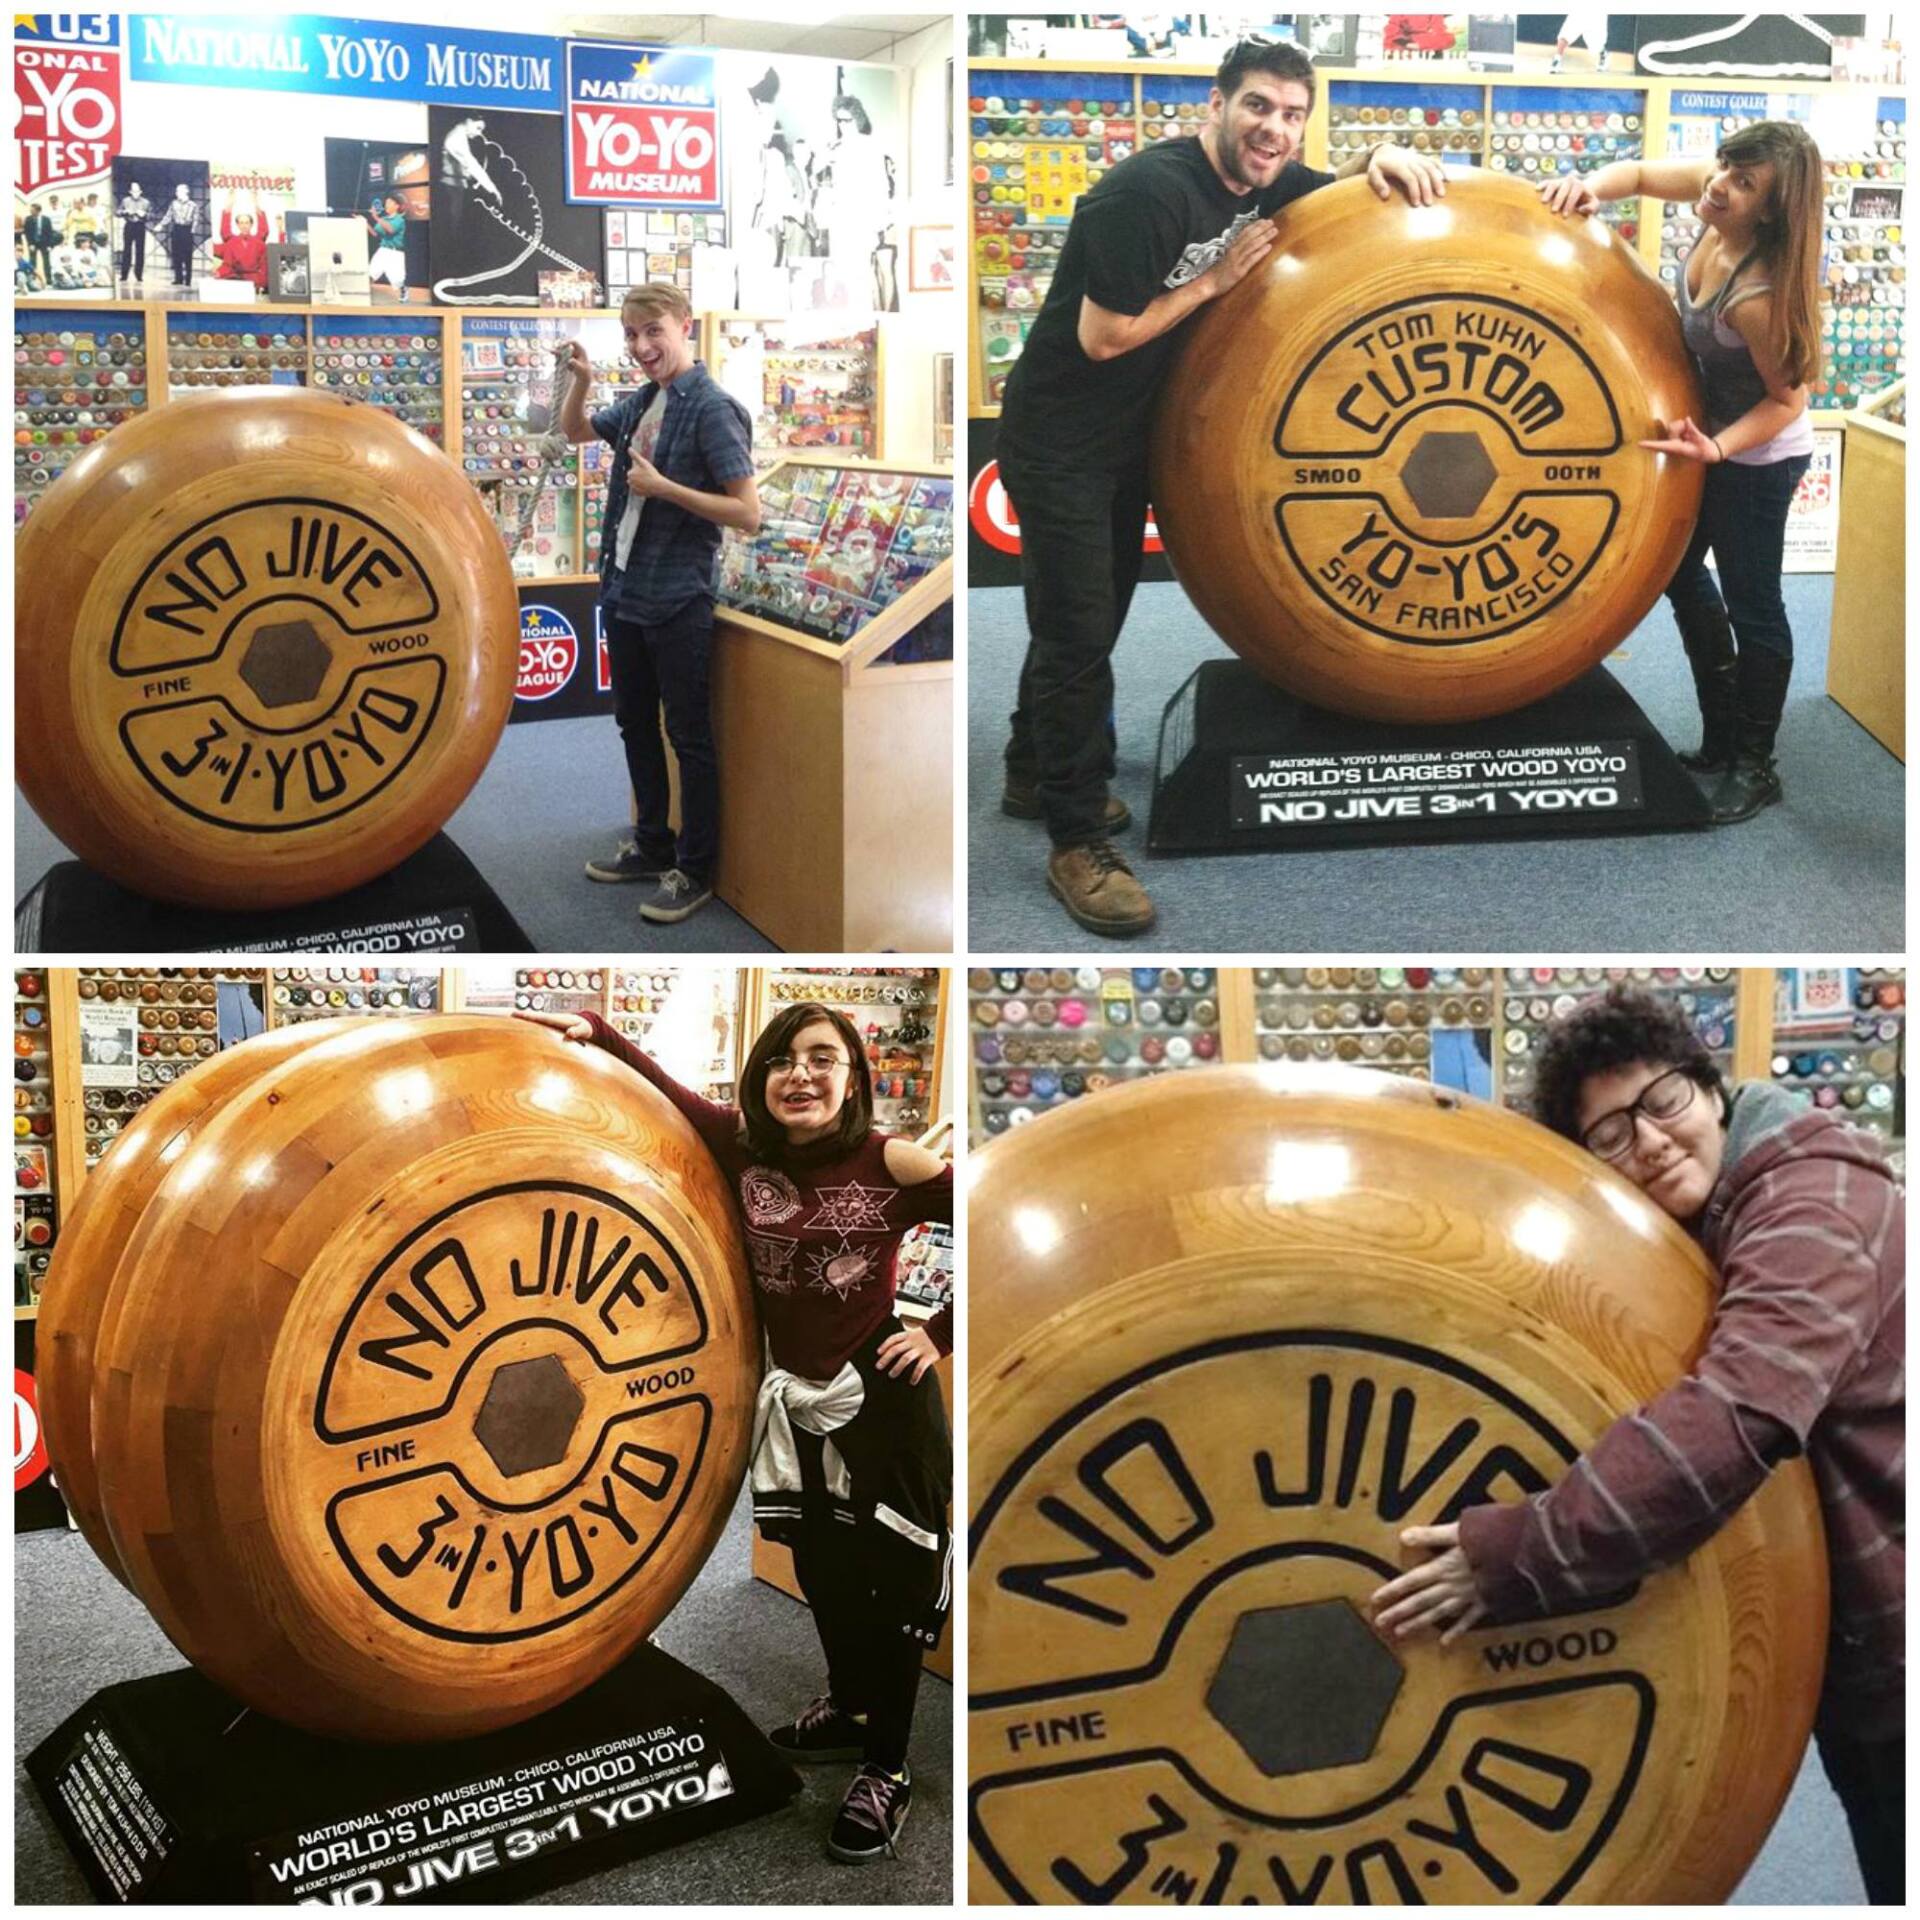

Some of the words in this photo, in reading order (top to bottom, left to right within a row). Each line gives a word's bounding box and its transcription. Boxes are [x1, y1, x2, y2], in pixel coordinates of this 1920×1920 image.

[16, 51, 108, 72] ONAL
[142, 17, 310, 73] NATIONAL
[425, 43, 552, 92] MUSEUM
[14, 69, 116, 140] -YO
[580, 79, 711, 105] NATIONAL
[1681, 94, 1728, 108] CONTEST
[14, 138, 109, 186] TEST
[210, 174, 295, 191] xaminer
[589, 171, 703, 194] MUSEUM
[471, 320, 508, 331] CONTEST
[1353, 312, 1435, 359] TOM
[1456, 311, 1547, 360] KUHN
[1335, 341, 1565, 435] CUSTOM
[1294, 468, 1362, 484] SMOO
[1341, 511, 1561, 602] YO-YO'S
[144, 535, 247, 635] NO
[266, 516, 403, 608] JIVE
[1319, 556, 1383, 614] SAN
[1396, 552, 1574, 631] FRANCISCO
[368, 633, 429, 656] WOOD
[521, 626, 566, 638] TIONAL
[519, 641, 569, 673] O-YO
[143, 676, 192, 698] FINE
[517, 672, 564, 687] EAGUE
[1245, 768, 1361, 788] WORLD'S
[1368, 763, 1476, 783] LARGEST
[1481, 760, 1558, 778] WOOD
[1564, 756, 1626, 774] YOYO
[1269, 757, 1338, 769] NATIONAL
[1340, 754, 1378, 765] YOYO
[1379, 752, 1442, 764] MUSEUM
[1451, 750, 1494, 761] CHICO,
[1497, 747, 1573, 759] CALIFORNIA
[1575, 745, 1602, 756] USA
[1260, 801, 1326, 823] NO
[1334, 796, 1422, 819] JIVE
[1508, 787, 1618, 810] YOYO
[227, 939, 287, 953] MUSEUM
[296, 932, 339, 947] CHICO,
[341, 921, 413, 940] CALIFORNIA
[416, 915, 441, 927] USA
[327, 935, 402, 953] WOOD
[405, 924, 465, 947] YOYO
[358, 1237, 487, 1381] NO
[510, 1208, 670, 1335] JIVE
[625, 1366, 696, 1399] WOOD
[356, 1439, 417, 1472] FINE
[997, 1417, 1215, 1626] NO
[1482, 1627, 1618, 1674] WOOD
[1006, 1711, 1107, 1754] FINE
[297, 1812, 384, 1847] NATIONAL
[386, 1797, 430, 1820] YOYO
[434, 1776, 505, 1807] MUSEUM
[514, 1759, 564, 1783] CHICO,
[565, 1734, 646, 1767] CALIFORNIA
[647, 1725, 676, 1743] USA
[269, 1821, 417, 1883] WORLD'S
[423, 1780, 546, 1836] LARGEST
[552, 1755, 636, 1795] WOOD
[638, 1733, 704, 1767] YOYO
[294, 1885, 305, 1895] AN
[306, 1876, 329, 1891] EXACT
[329, 1869, 357, 1885] SCALED
[357, 1864, 368, 1875] UP
[369, 1858, 397, 1872] REPLICA
[397, 1853, 407, 1863] OF
[408, 1849, 421, 1859] THE
[450, 1833, 469, 1845] FIRST
[470, 1820, 509, 1840] COMPLETELY
[575, 1793, 594, 1806] WHICH
[595, 1789, 607, 1798] MAY
[608, 1786, 616, 1795] BE
[616, 1775, 649, 1793] ASSEMBLED
[654, 1765, 682, 1780] DIFFERENT
[393, 1839, 500, 1897] JIVE
[589, 1773, 706, 1829] YOYO
